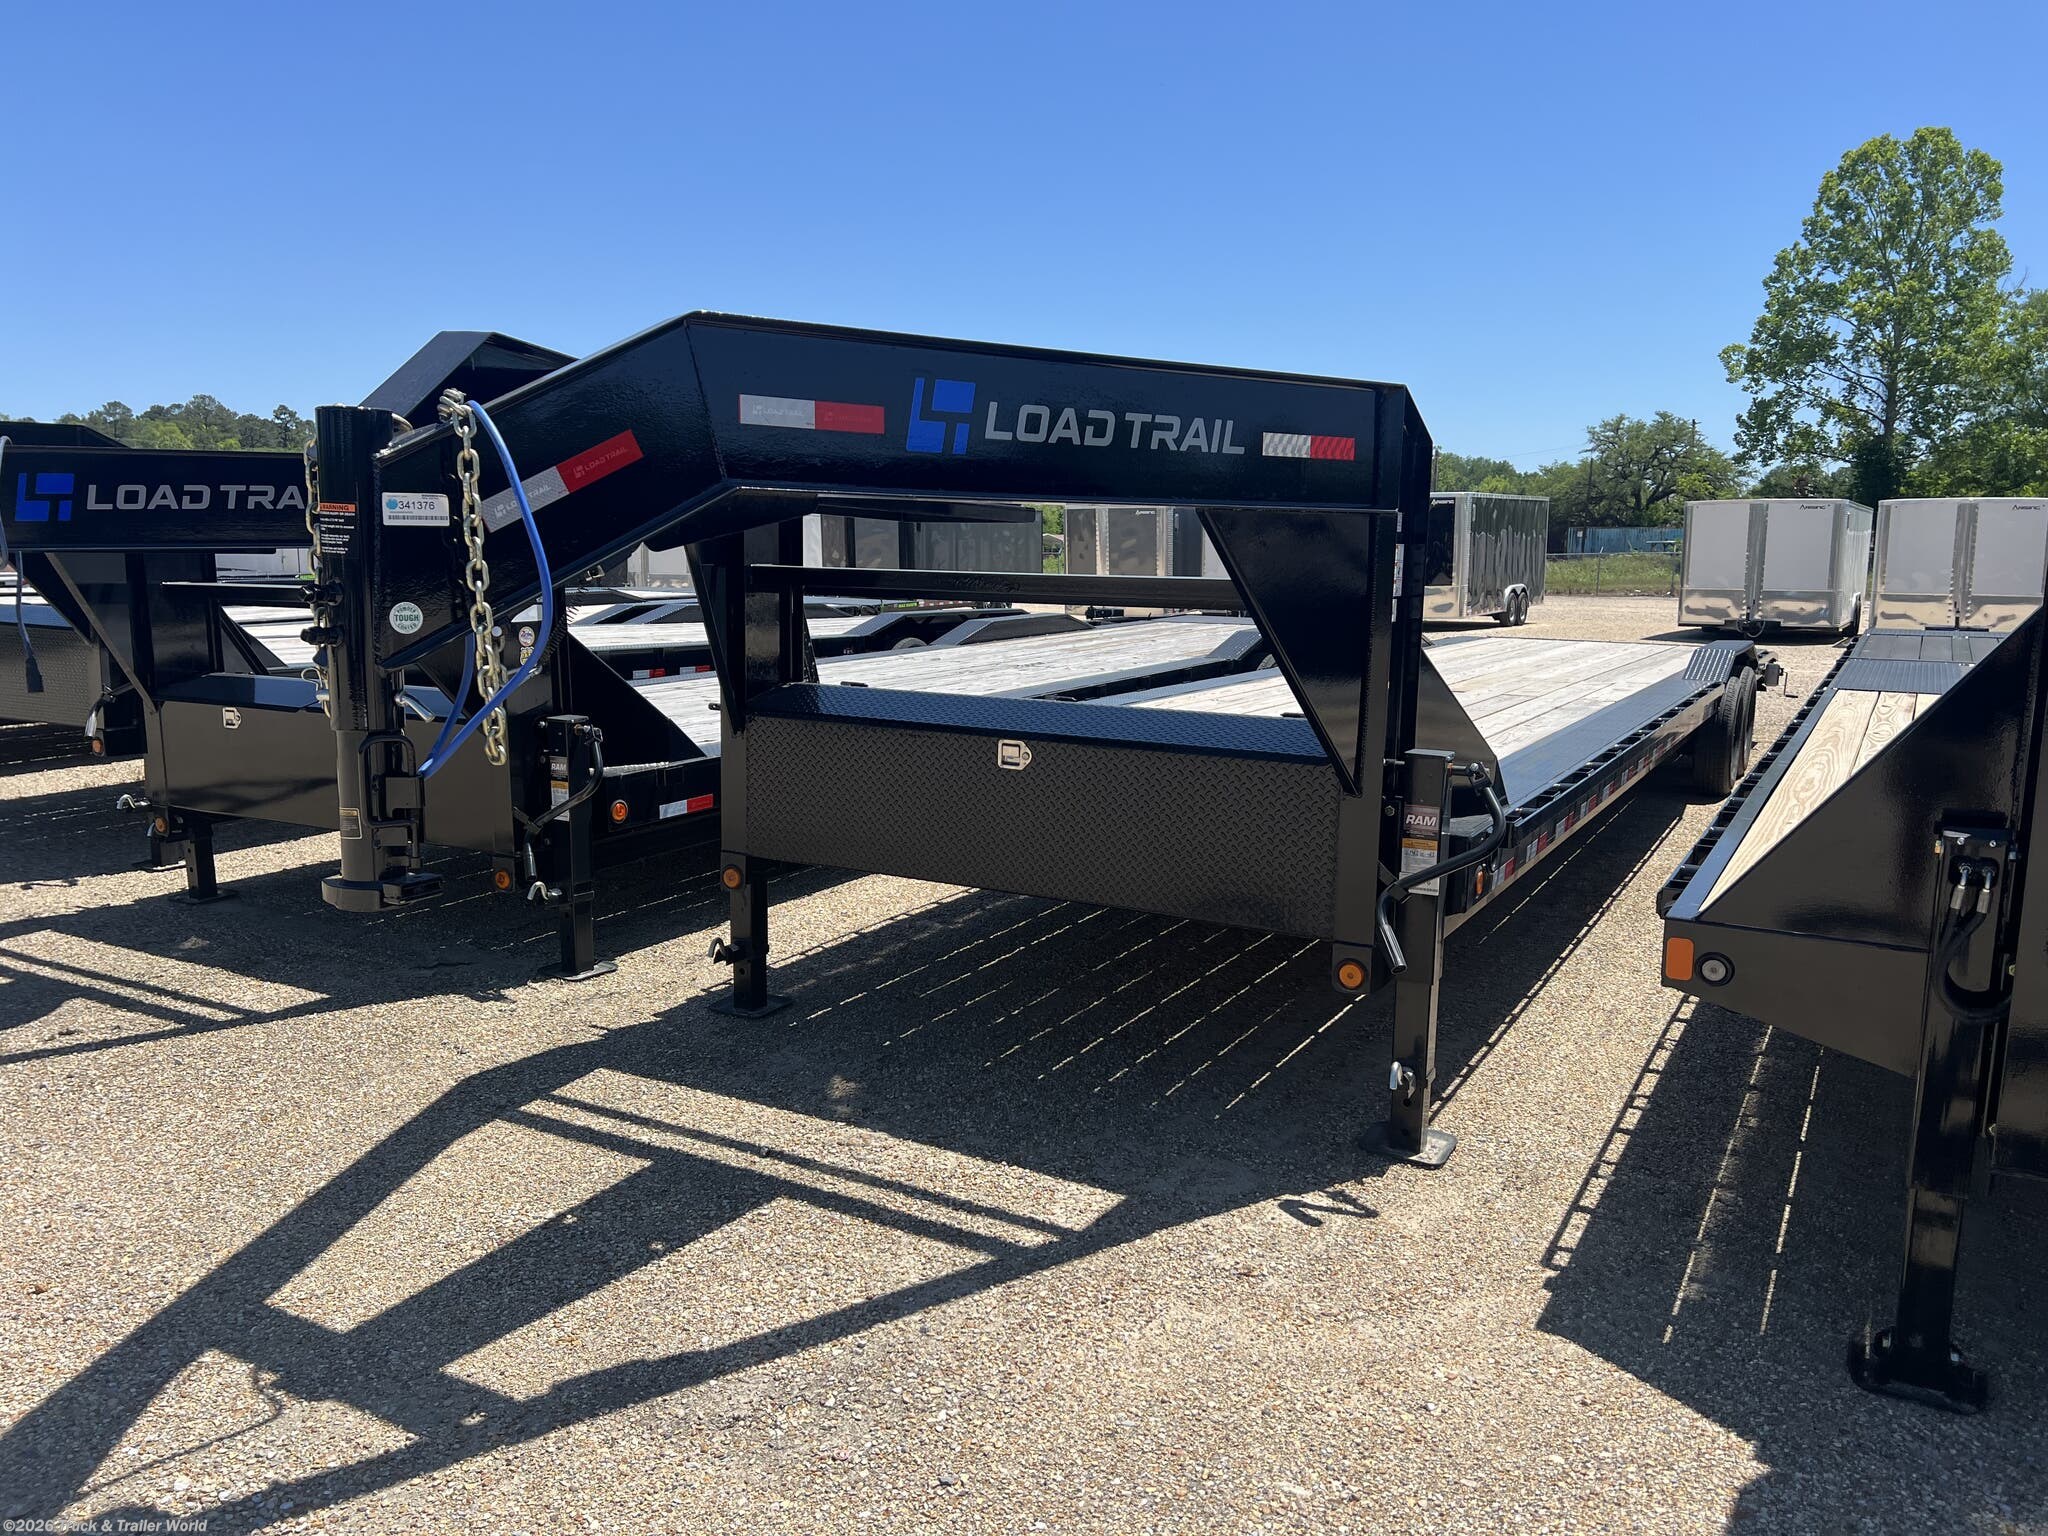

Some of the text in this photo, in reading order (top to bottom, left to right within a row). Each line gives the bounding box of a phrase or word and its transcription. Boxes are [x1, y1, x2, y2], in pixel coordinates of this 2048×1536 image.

[984, 401, 1116, 447] LOAD
[1124, 412, 1246, 455] TRAIL
[86, 484, 212, 510] LOAD
[219, 485, 305, 510] TRA
[398, 500, 436, 510] 341376
[394, 614, 420, 622] TOUGH
[1406, 814, 1436, 826] RAM
